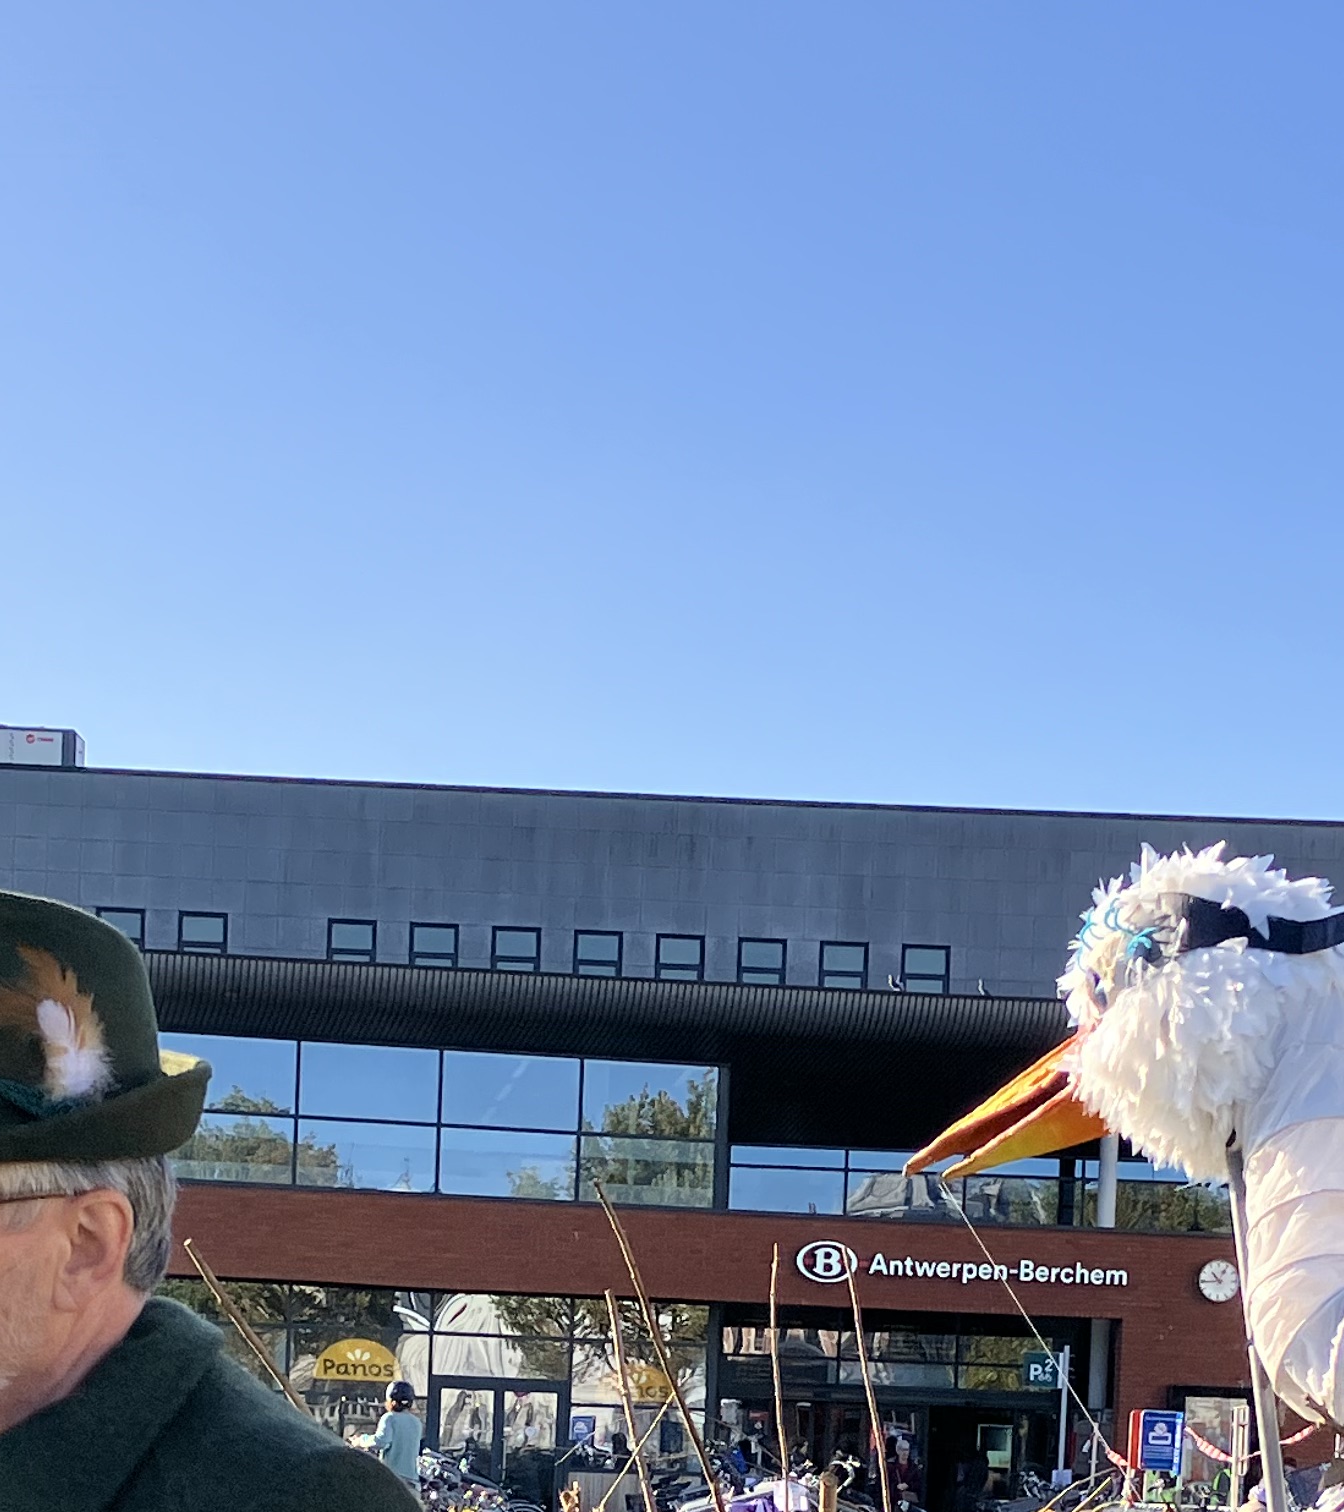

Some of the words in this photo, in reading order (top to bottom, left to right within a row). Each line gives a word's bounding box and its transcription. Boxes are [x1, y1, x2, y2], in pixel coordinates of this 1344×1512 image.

[813, 1247, 842, 1277] B
[869, 1253, 1128, 1287] Antwerpen-Berchem
[323, 1358, 394, 1377] Panos
[1029, 1363, 1043, 1381] P
